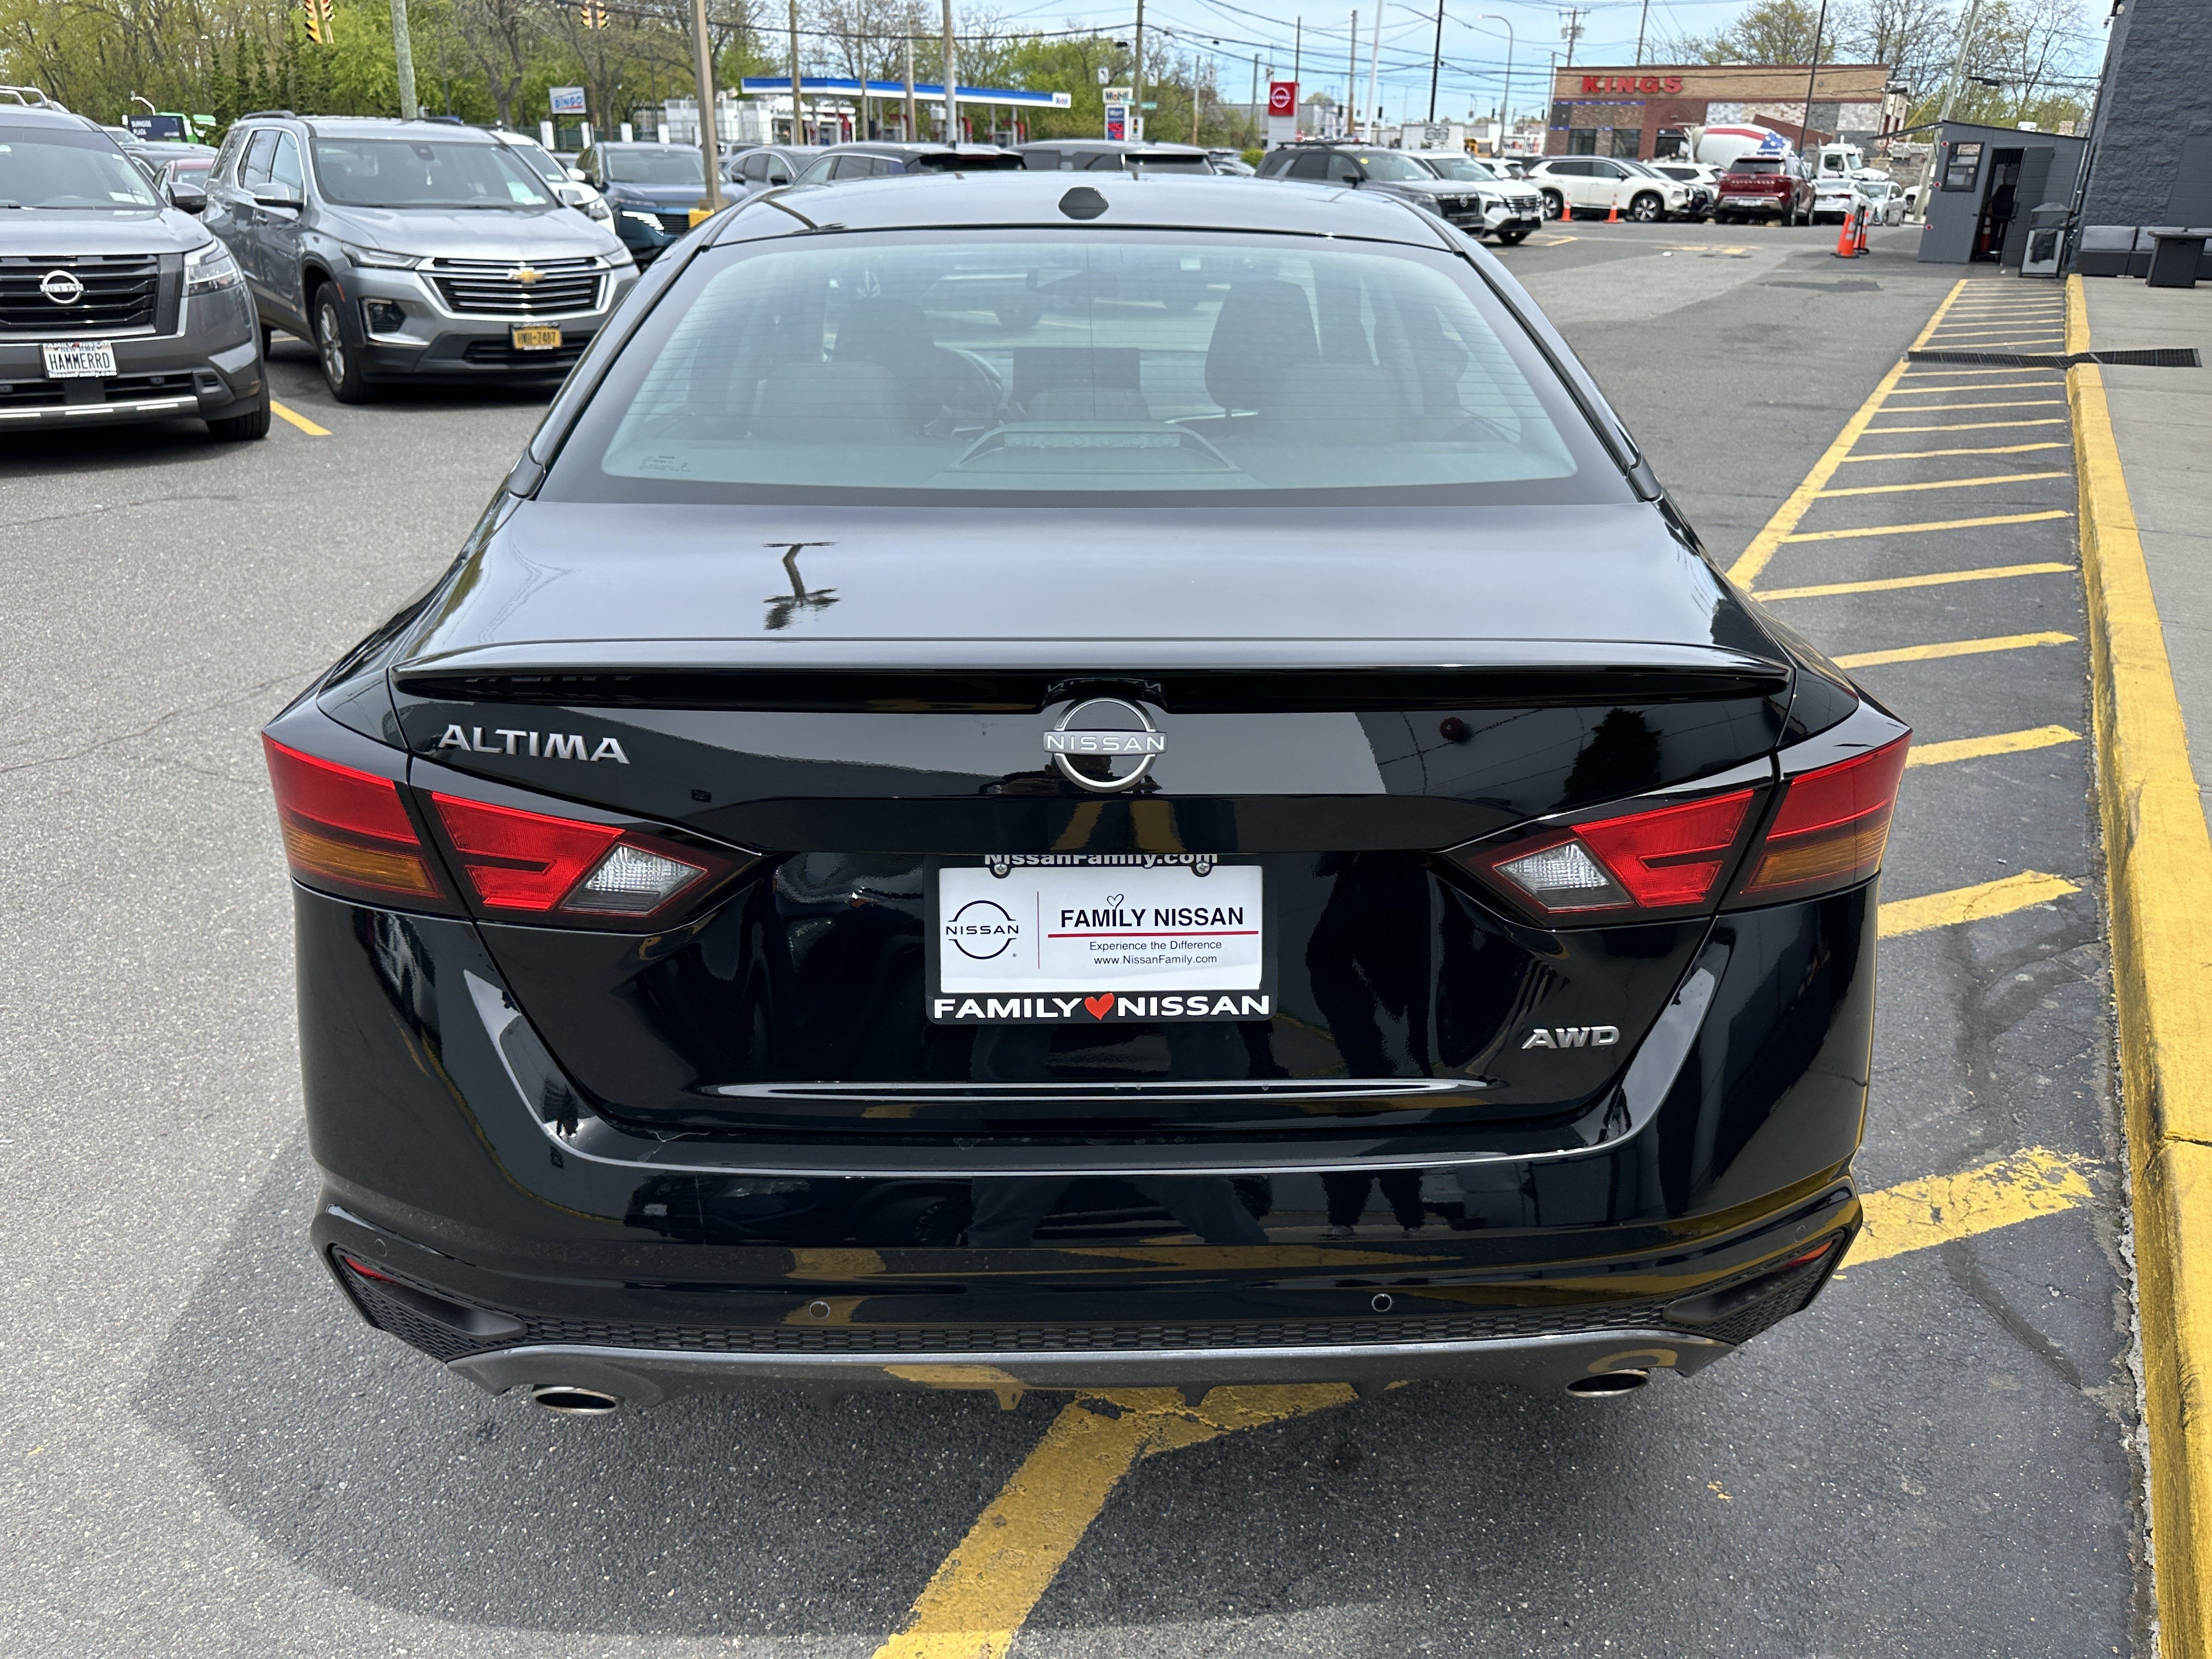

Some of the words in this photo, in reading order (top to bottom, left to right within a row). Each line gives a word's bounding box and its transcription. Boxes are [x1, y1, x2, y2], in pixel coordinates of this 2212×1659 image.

[1582, 76, 1682, 93] KINGS
[49, 352, 110, 370] HAMMERRD
[438, 724, 631, 764] ALTIMA
[1047, 735, 1164, 751] NISSAN
[1060, 909, 1147, 927] FAMILY
[1154, 907, 1244, 926] NISSAN
[946, 924, 1019, 935] NISSAN
[1089, 941, 1147, 952] Experience
[1150, 941, 1166, 950] the
[1170, 940, 1222, 950] Difference
[1094, 954, 1217, 965] www.NissanFamily.com
[934, 997, 1083, 1019] FAMILY
[1117, 995, 1270, 1017] NISSAN
[1521, 1025, 1620, 1049] AWD
